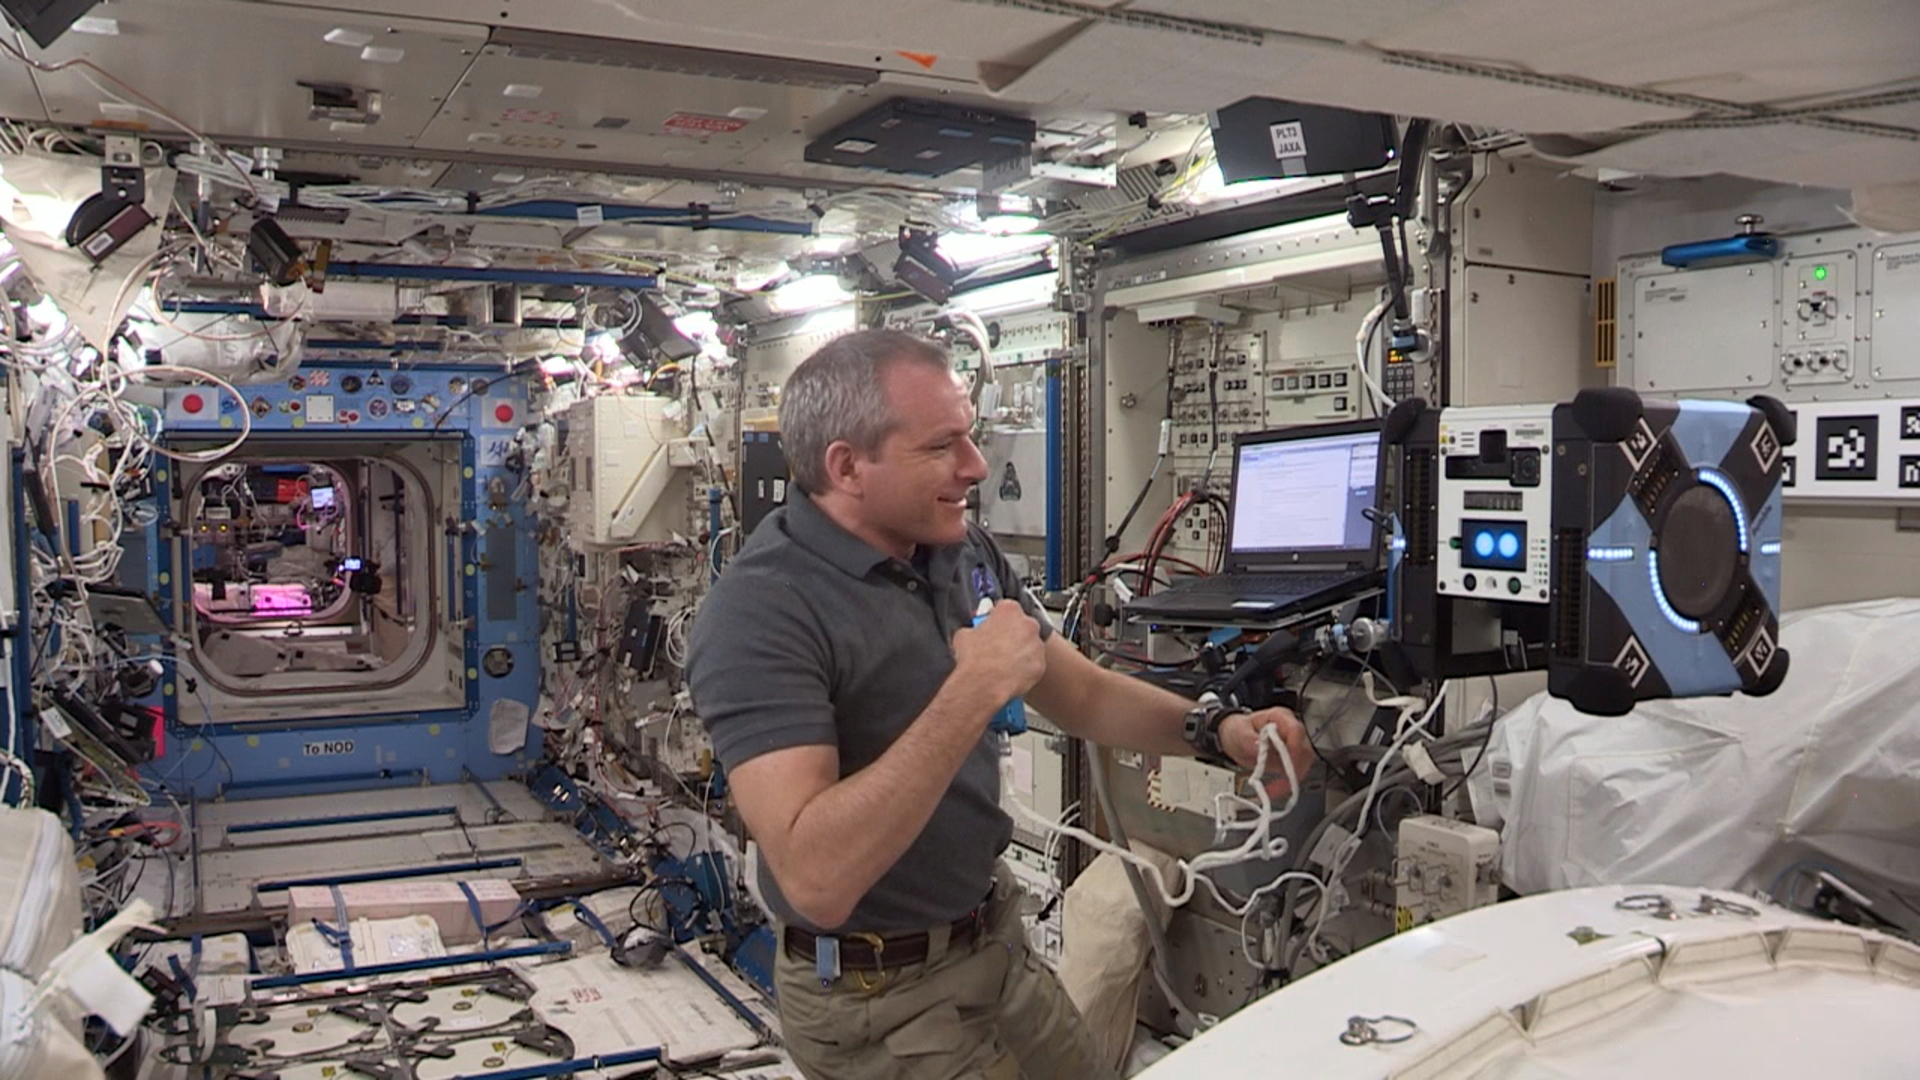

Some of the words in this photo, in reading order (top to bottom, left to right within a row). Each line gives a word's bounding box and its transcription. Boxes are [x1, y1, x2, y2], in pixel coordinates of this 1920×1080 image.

[1276, 126, 1298, 139] PLT3
[1279, 141, 1303, 154] JAXA
[304, 743, 320, 756] To
[324, 741, 354, 754] NOD
